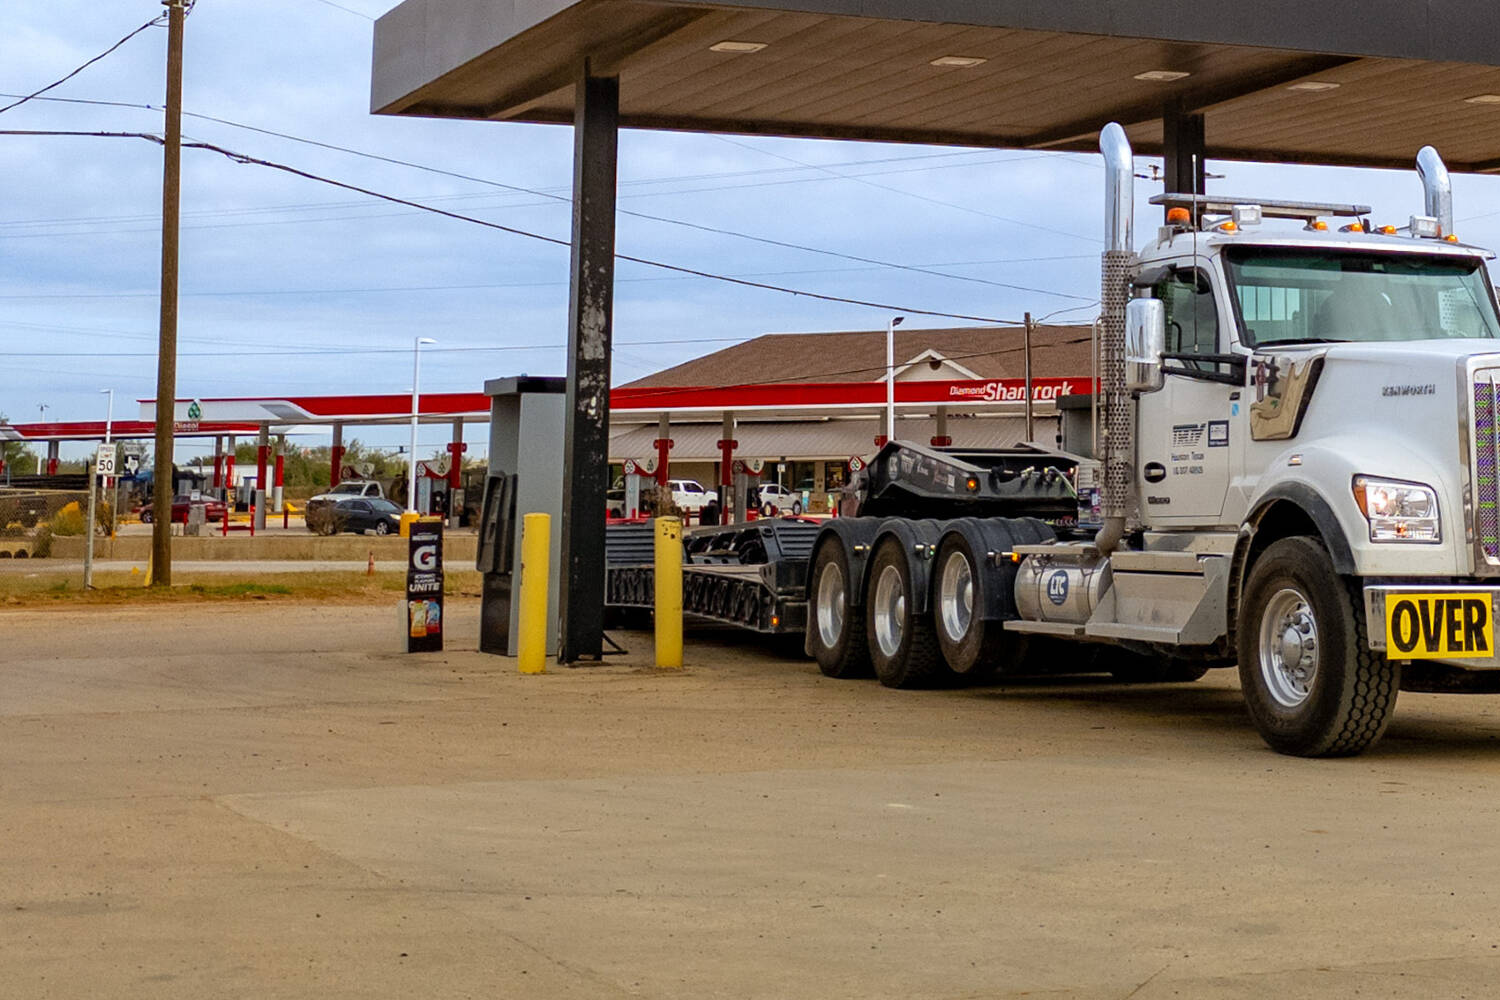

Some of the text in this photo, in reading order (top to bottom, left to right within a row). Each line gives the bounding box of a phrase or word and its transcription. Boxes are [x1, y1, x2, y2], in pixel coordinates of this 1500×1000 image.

[949, 385, 986, 396] Diamond
[99, 460, 113, 471] 50
[413, 545, 437, 571] G
[409, 582, 440, 592] UNITE
[1390, 598, 1489, 652] OVER
